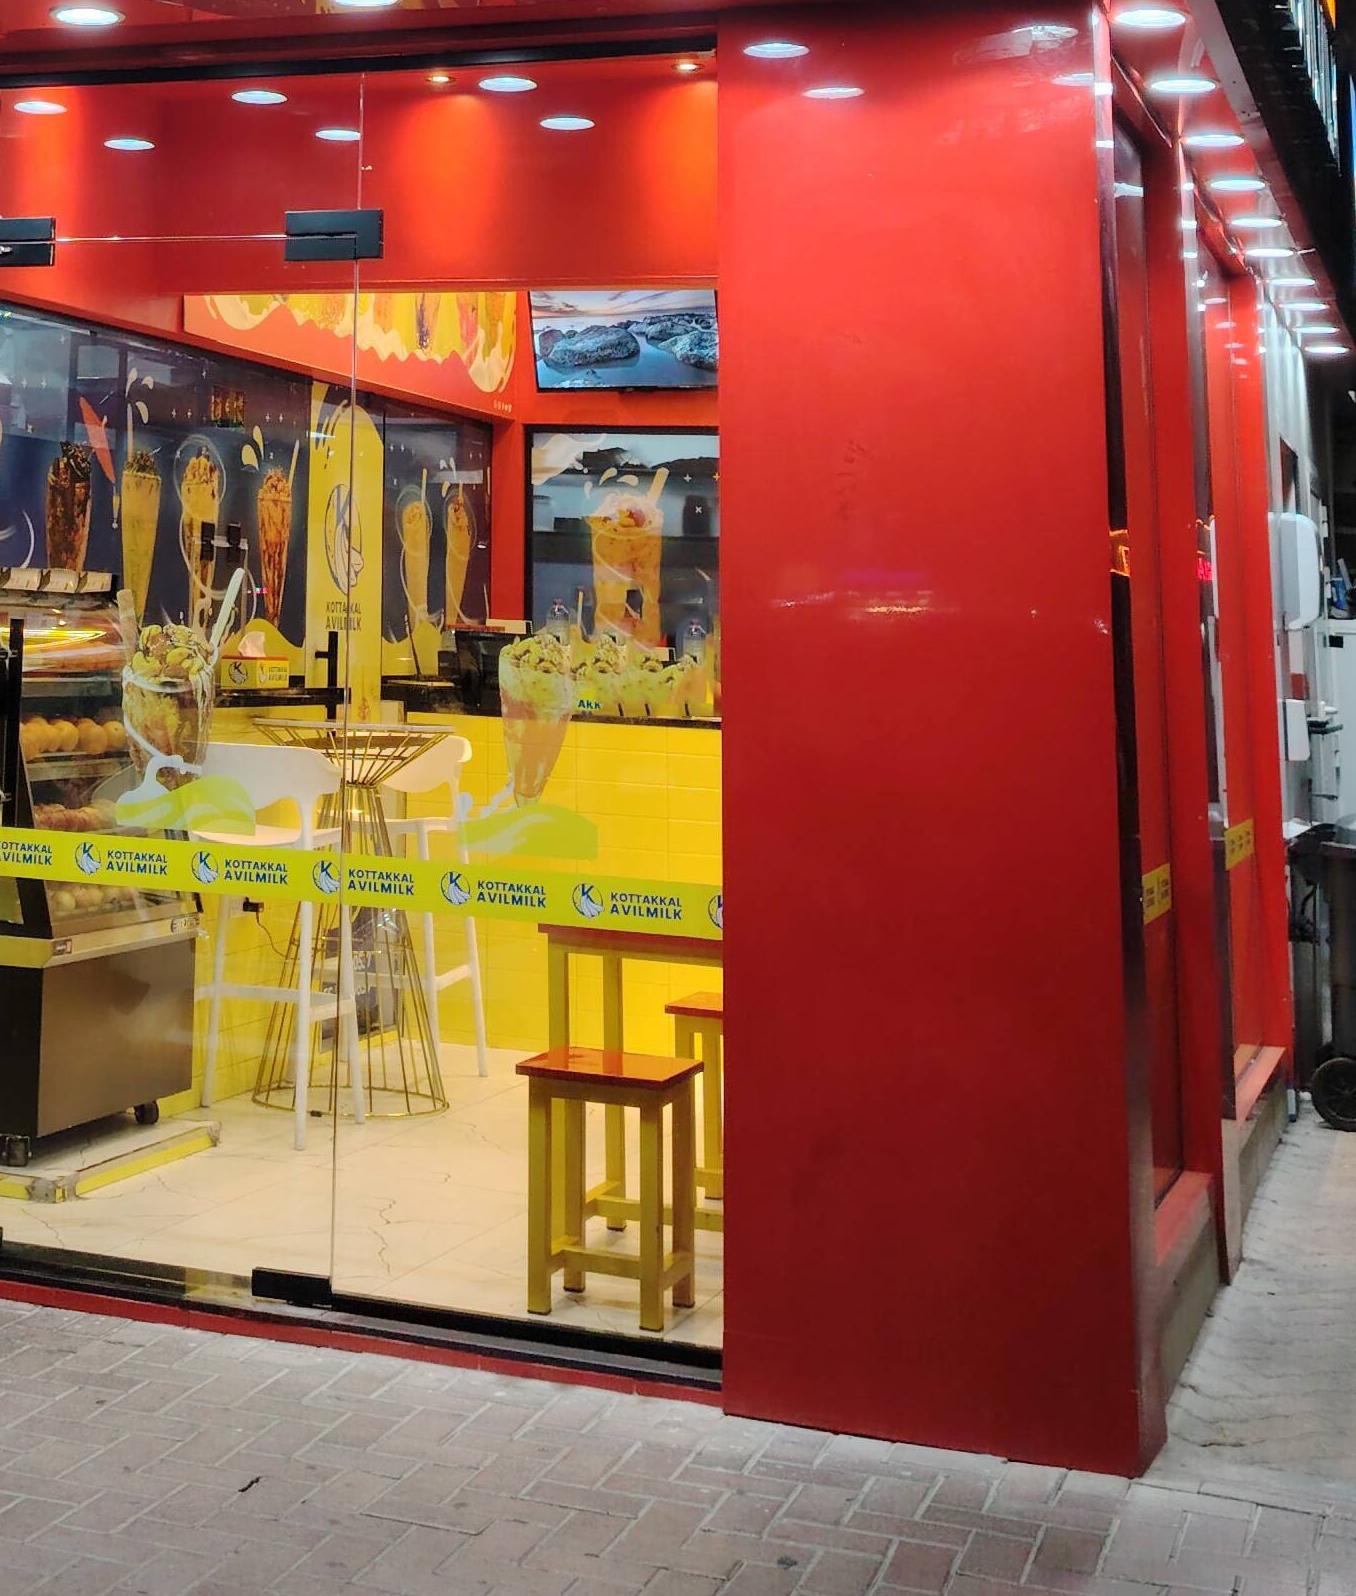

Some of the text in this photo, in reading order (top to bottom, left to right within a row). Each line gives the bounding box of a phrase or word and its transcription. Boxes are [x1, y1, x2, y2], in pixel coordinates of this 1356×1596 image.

[325, 601, 361, 614] KOTTAKAL
[107, 850, 167, 864] KOTTAKKAL
[106, 860, 168, 875] AVILMILK
[225, 859, 288, 873] KOTTAKKAL
[224, 870, 288, 885] AVILMILK
[348, 868, 414, 883] KOTTAKKAL
[347, 879, 414, 895] AVILMILK
[477, 880, 546, 895] KOTTAKKAL
[477, 892, 546, 908] AVILMILK
[610, 892, 682, 907] KOTTAKKAL
[610, 904, 682, 920] AVILMILK
